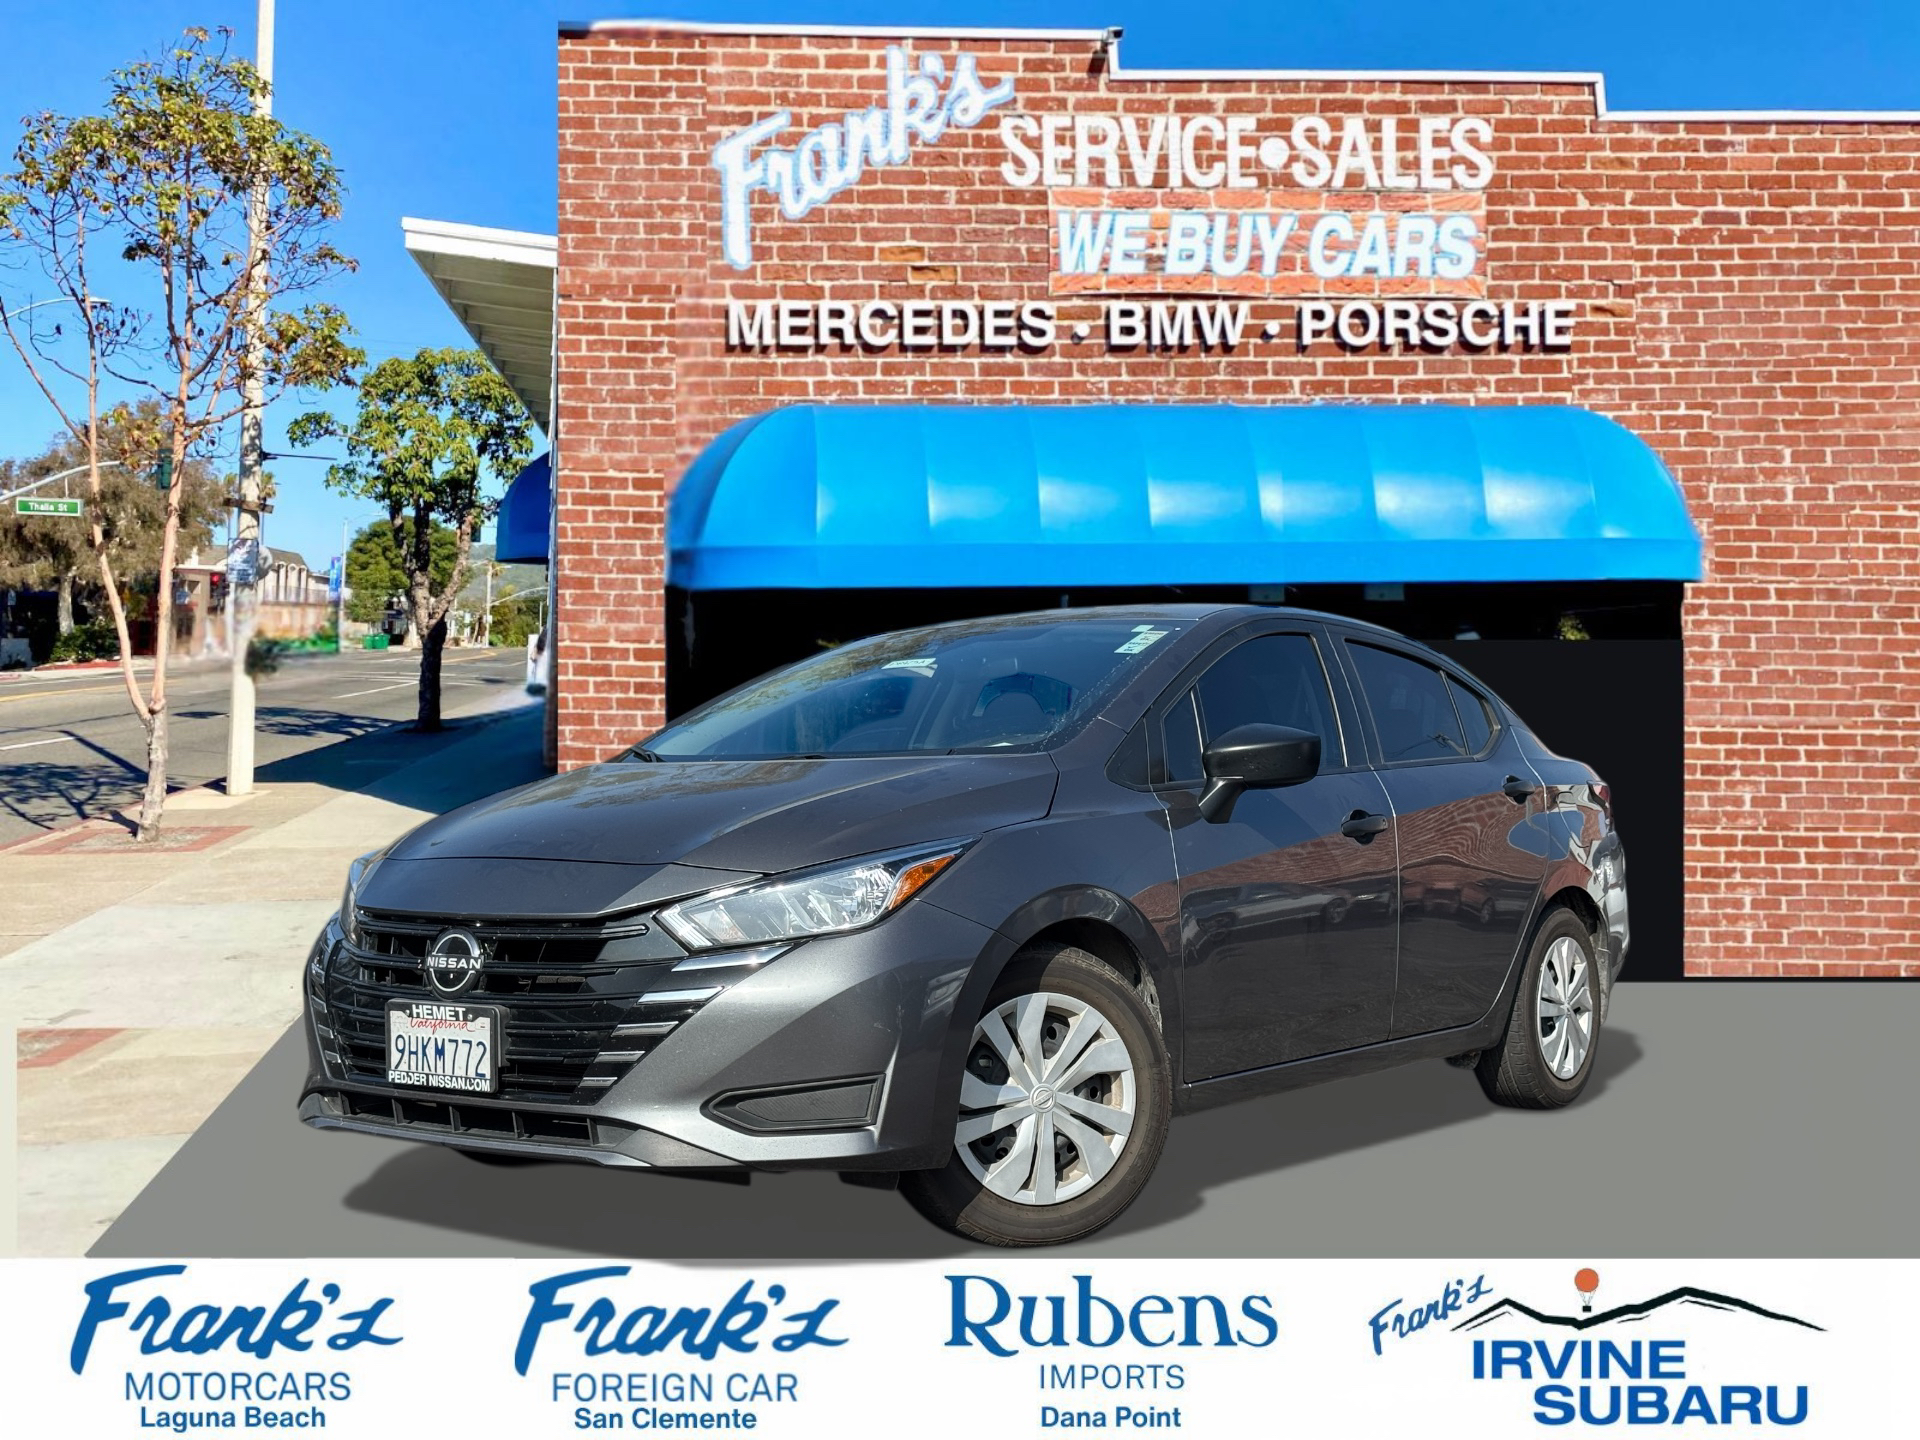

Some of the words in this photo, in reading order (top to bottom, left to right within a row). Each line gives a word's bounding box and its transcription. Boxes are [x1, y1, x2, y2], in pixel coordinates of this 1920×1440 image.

[713, 46, 1016, 270] Frank's
[1001, 115, 1259, 190] SERVICE
[1291, 116, 1493, 191] SALES
[1056, 208, 1149, 277] WE
[1165, 209, 1298, 277] BUY
[1308, 210, 1479, 279] CARS
[727, 299, 1056, 349] MERCEDES
[1107, 300, 1251, 349] BMW
[1299, 299, 1575, 350] PORSCHE
[57, 503, 68, 512] St
[427, 957, 483, 970] NISSAN
[411, 1004, 467, 1021] HEMET
[395, 1033, 488, 1079] 9HKM772
[388, 1070, 427, 1087] PEDDER
[428, 1074, 491, 1093] NISSAN.COM
